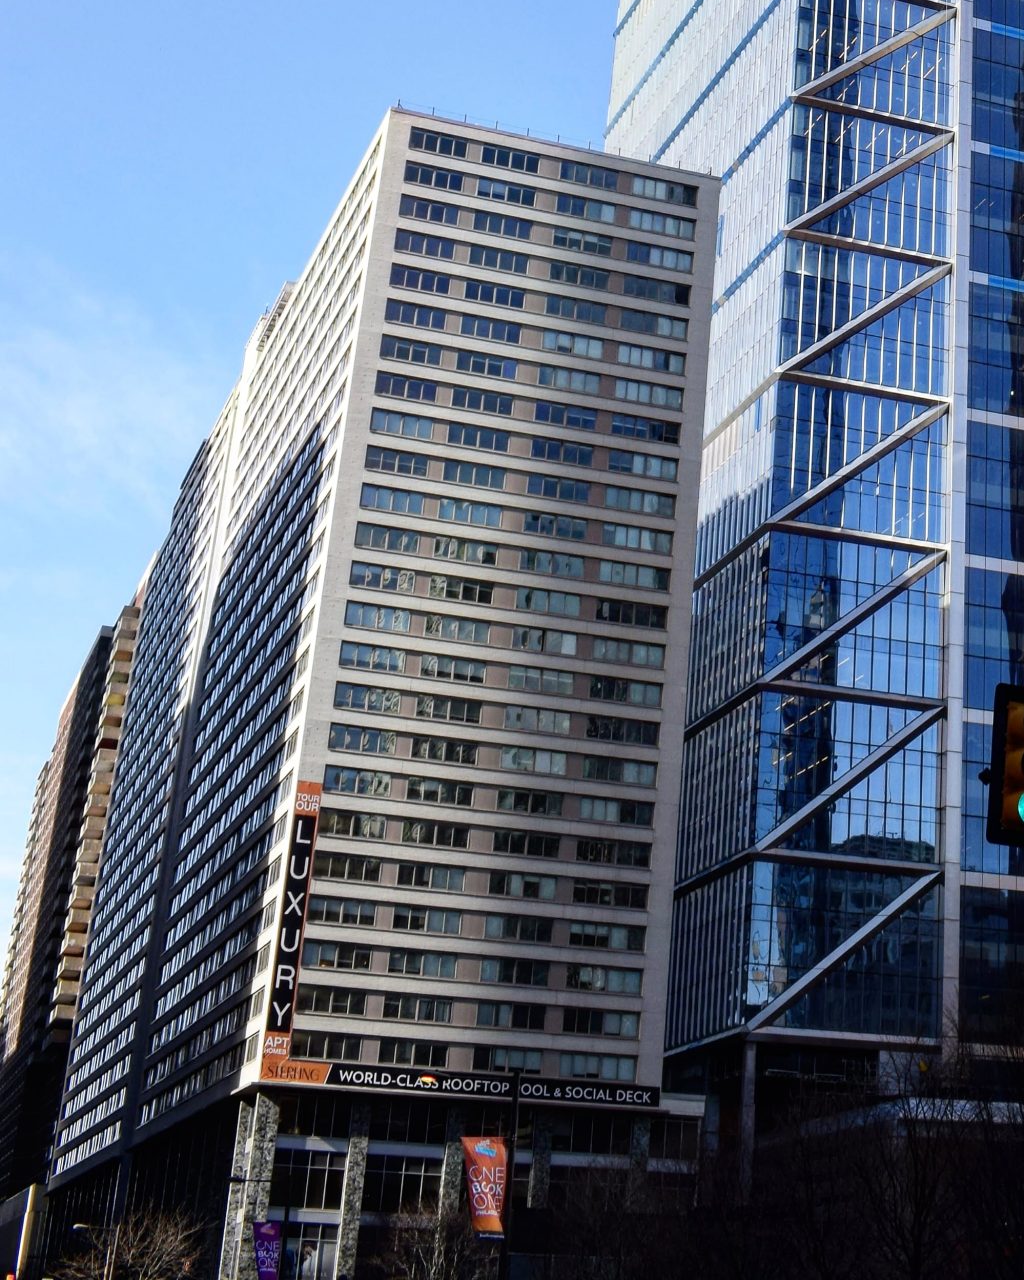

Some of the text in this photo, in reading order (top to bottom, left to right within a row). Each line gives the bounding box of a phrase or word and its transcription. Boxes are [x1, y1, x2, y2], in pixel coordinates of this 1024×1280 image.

[296, 792, 320, 803] TOUR
[295, 800, 319, 812] OUR
[272, 820, 311, 1027] LUXURY
[264, 1035, 290, 1048] APT
[442, 1077, 510, 1094] ROOFTOP
[553, 1087, 562, 1097] &
[565, 1086, 612, 1101] SOCIAL
[616, 1089, 651, 1104] DECK
